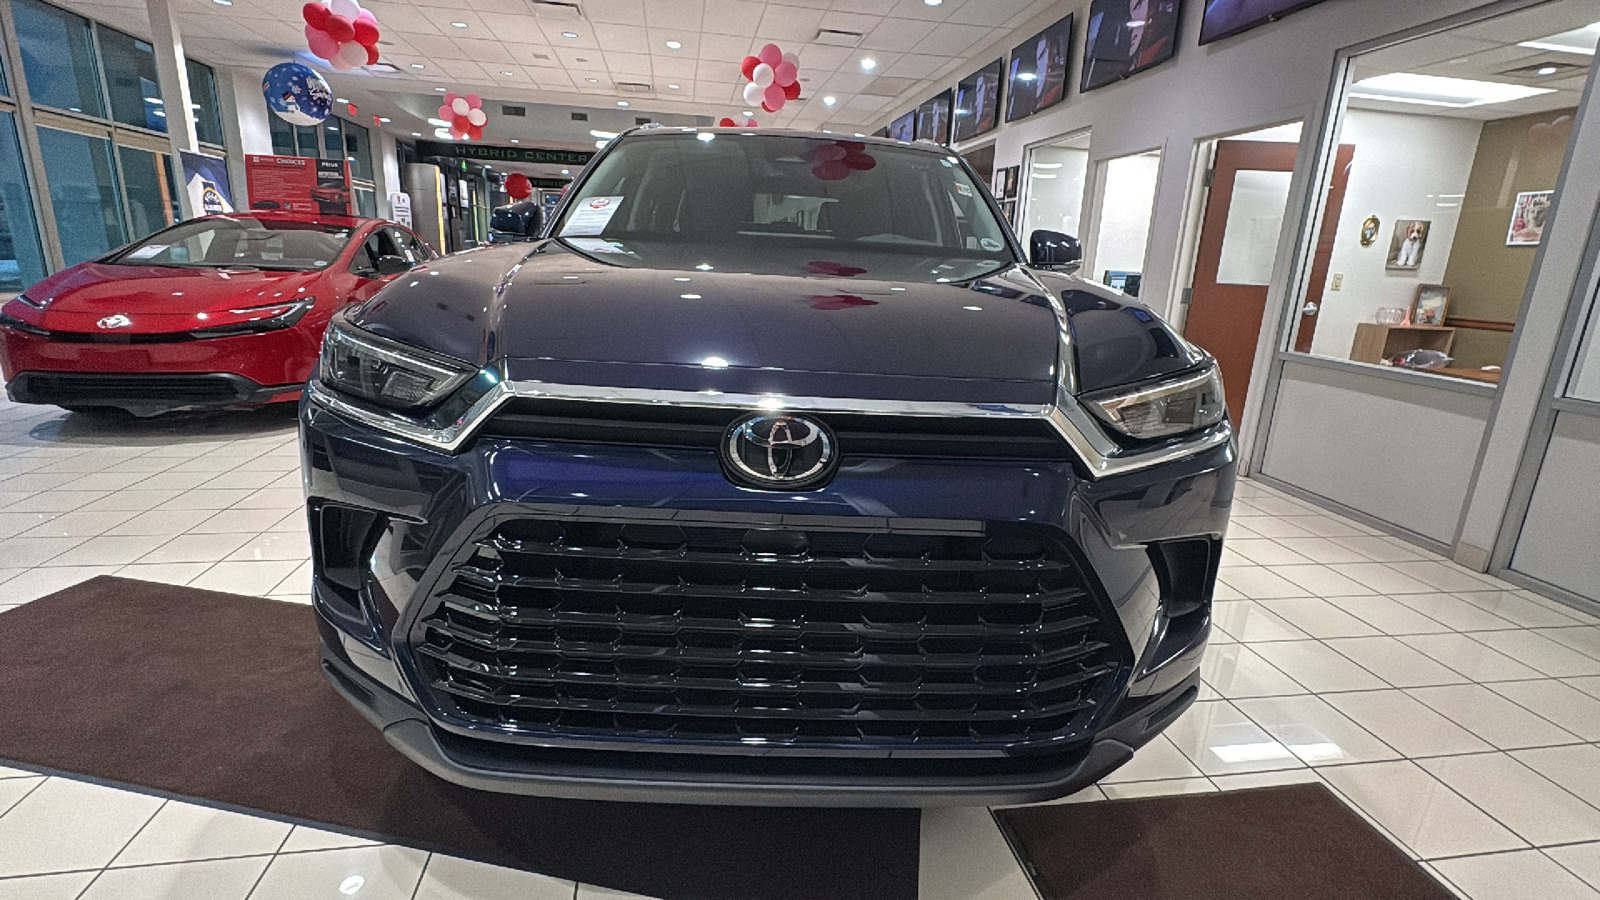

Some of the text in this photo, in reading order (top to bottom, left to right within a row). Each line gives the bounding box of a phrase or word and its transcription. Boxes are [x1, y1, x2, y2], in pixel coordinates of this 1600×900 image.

[455, 146, 588, 162] HYBRID CENTER
[276, 158, 306, 166] CHOICES
